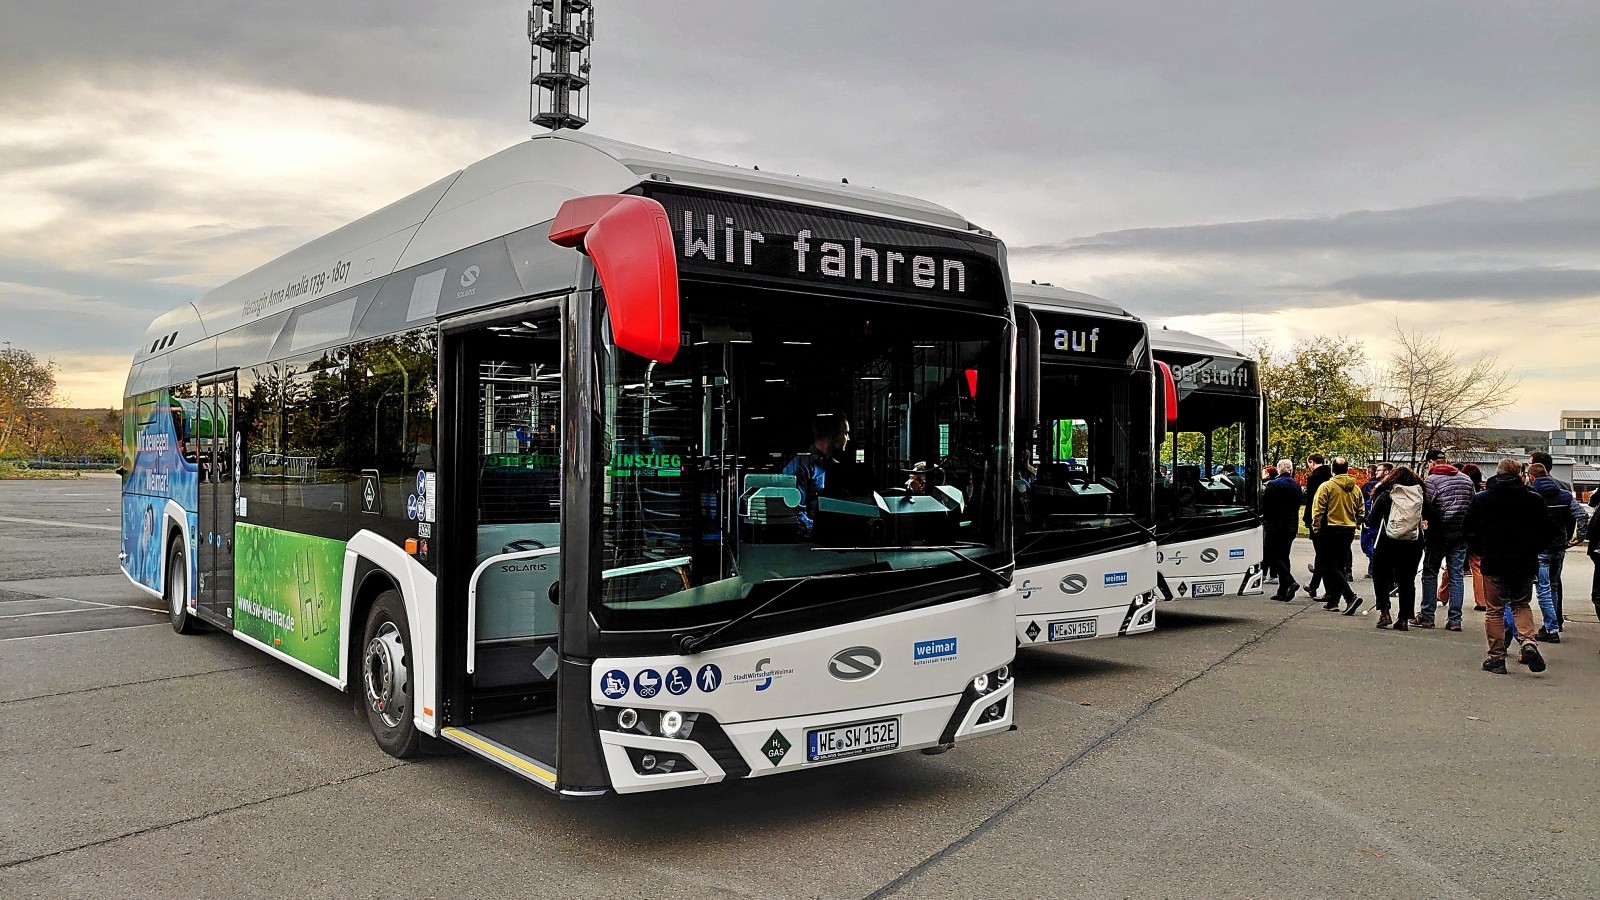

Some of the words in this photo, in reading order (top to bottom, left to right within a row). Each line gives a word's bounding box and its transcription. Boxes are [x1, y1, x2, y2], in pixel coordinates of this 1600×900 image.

[684, 210, 765, 265] Wir
[793, 229, 965, 292] fahren
[241, 293, 268, 317] Herzogin
[267, 289, 285, 308] Anna
[284, 275, 309, 302] Amalia
[309, 272, 325, 295] 1739
[331, 260, 351, 284] 1807
[1054, 327, 1100, 353] auf
[1169, 363, 1248, 387] serstoff!
[611, 454, 681, 468] INSTIEG
[501, 563, 548, 573] SOLARIS
[1105, 573, 1127, 583] weimar
[237, 595, 295, 632] www.sw-weimar.de
[1054, 624, 1064, 637] WE
[1067, 623, 1077, 636] SW
[1077, 621, 1095, 635] 151E
[916, 642, 955, 656] weimar
[819, 731, 836, 752] WE
[845, 728, 861, 747] SW
[864, 723, 895, 745] 152E
[768, 748, 785, 757] GAS
